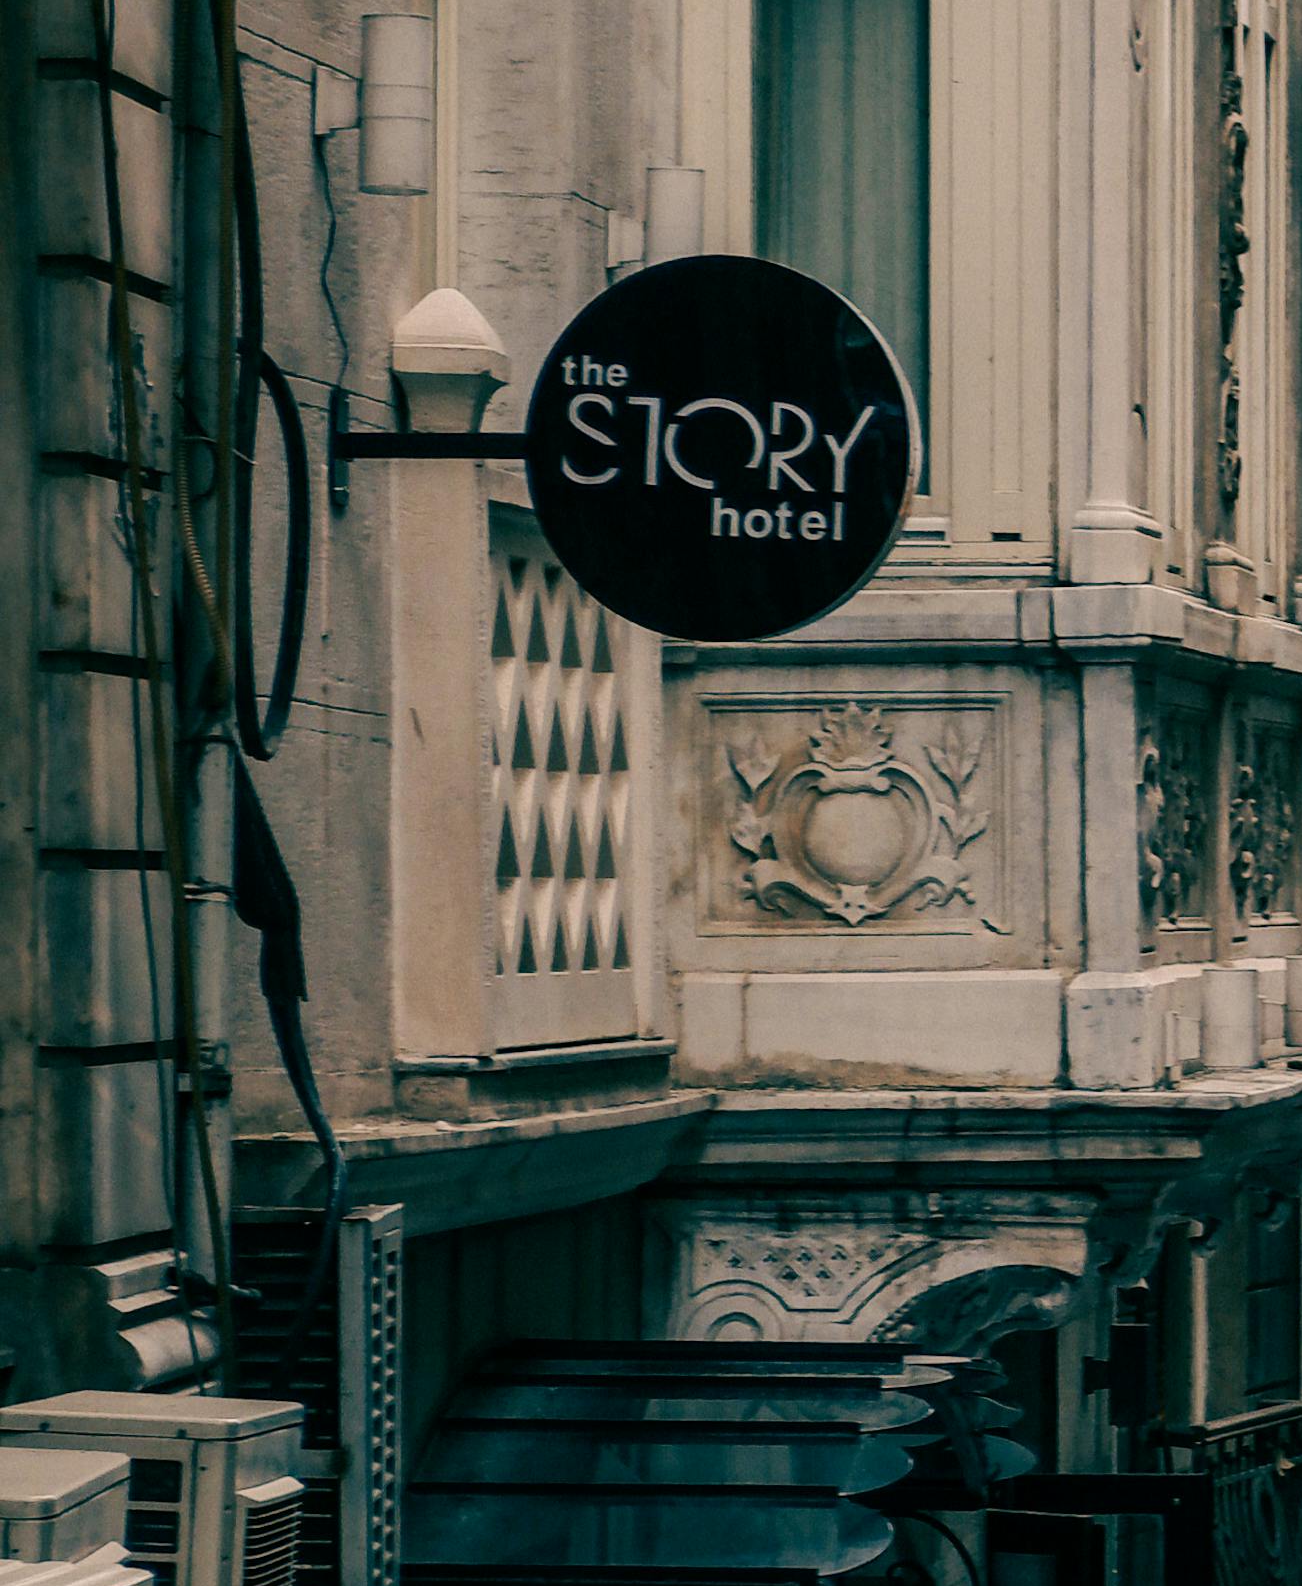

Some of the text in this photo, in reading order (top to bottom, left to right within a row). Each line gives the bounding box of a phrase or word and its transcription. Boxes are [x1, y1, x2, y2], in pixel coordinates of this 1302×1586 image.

[561, 355, 628, 387] the
[561, 393, 875, 493] STORY
[711, 498, 845, 541] hotel
